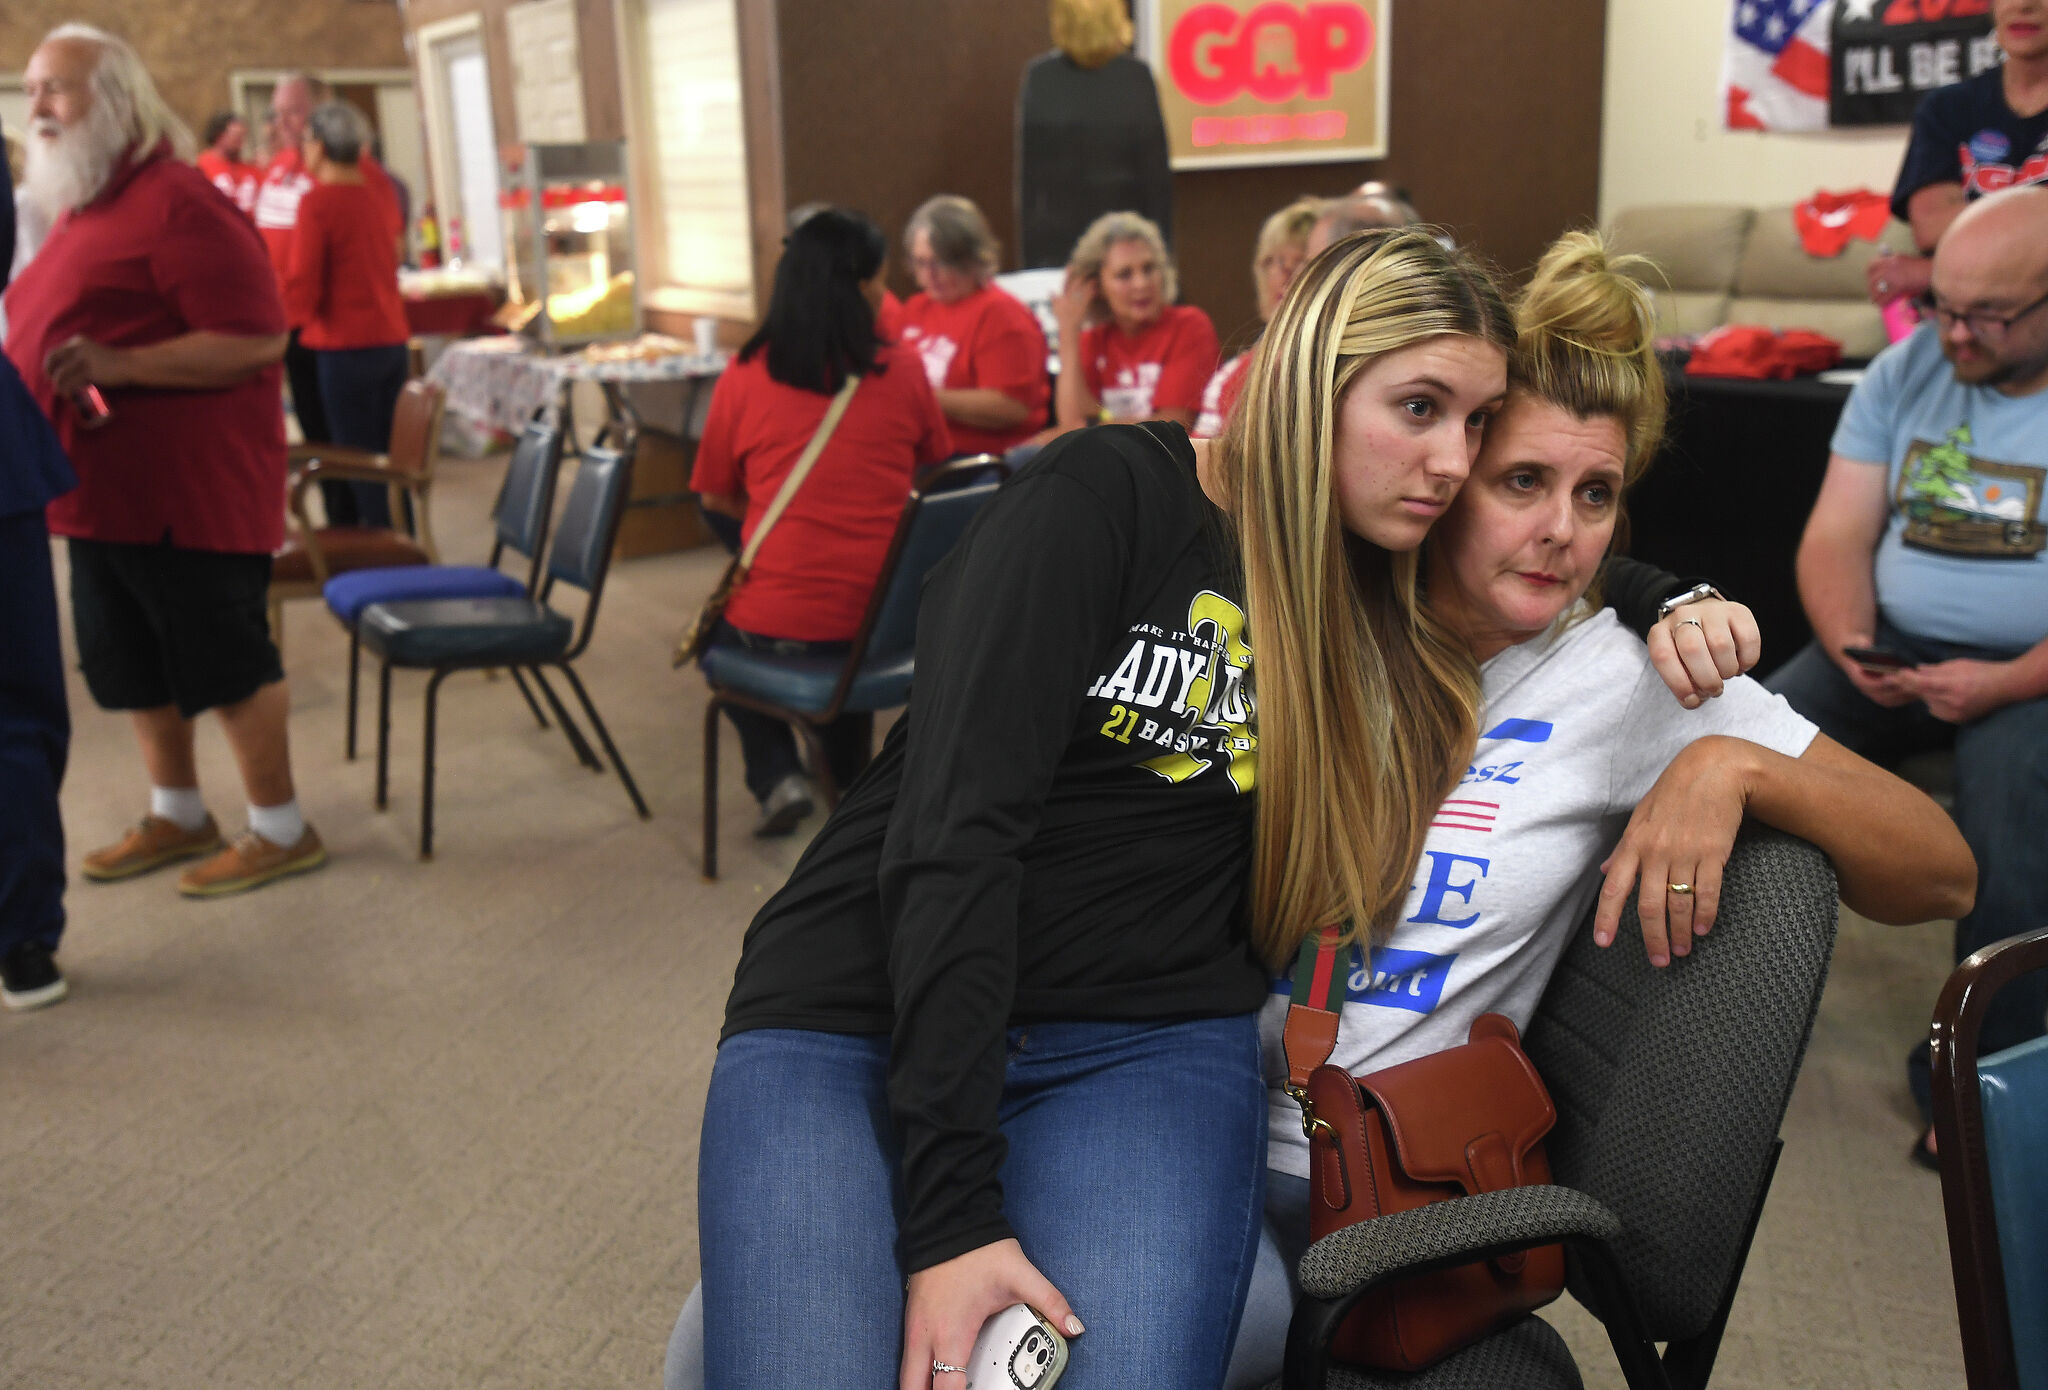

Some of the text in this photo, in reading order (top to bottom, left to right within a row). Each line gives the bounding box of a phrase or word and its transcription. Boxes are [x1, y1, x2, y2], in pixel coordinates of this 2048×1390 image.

[1167, 2, 1375, 106] GOP
[1909, 40, 1961, 90] BE
[1171, 631, 1187, 642] IT
[1100, 704, 1140, 745] 21
